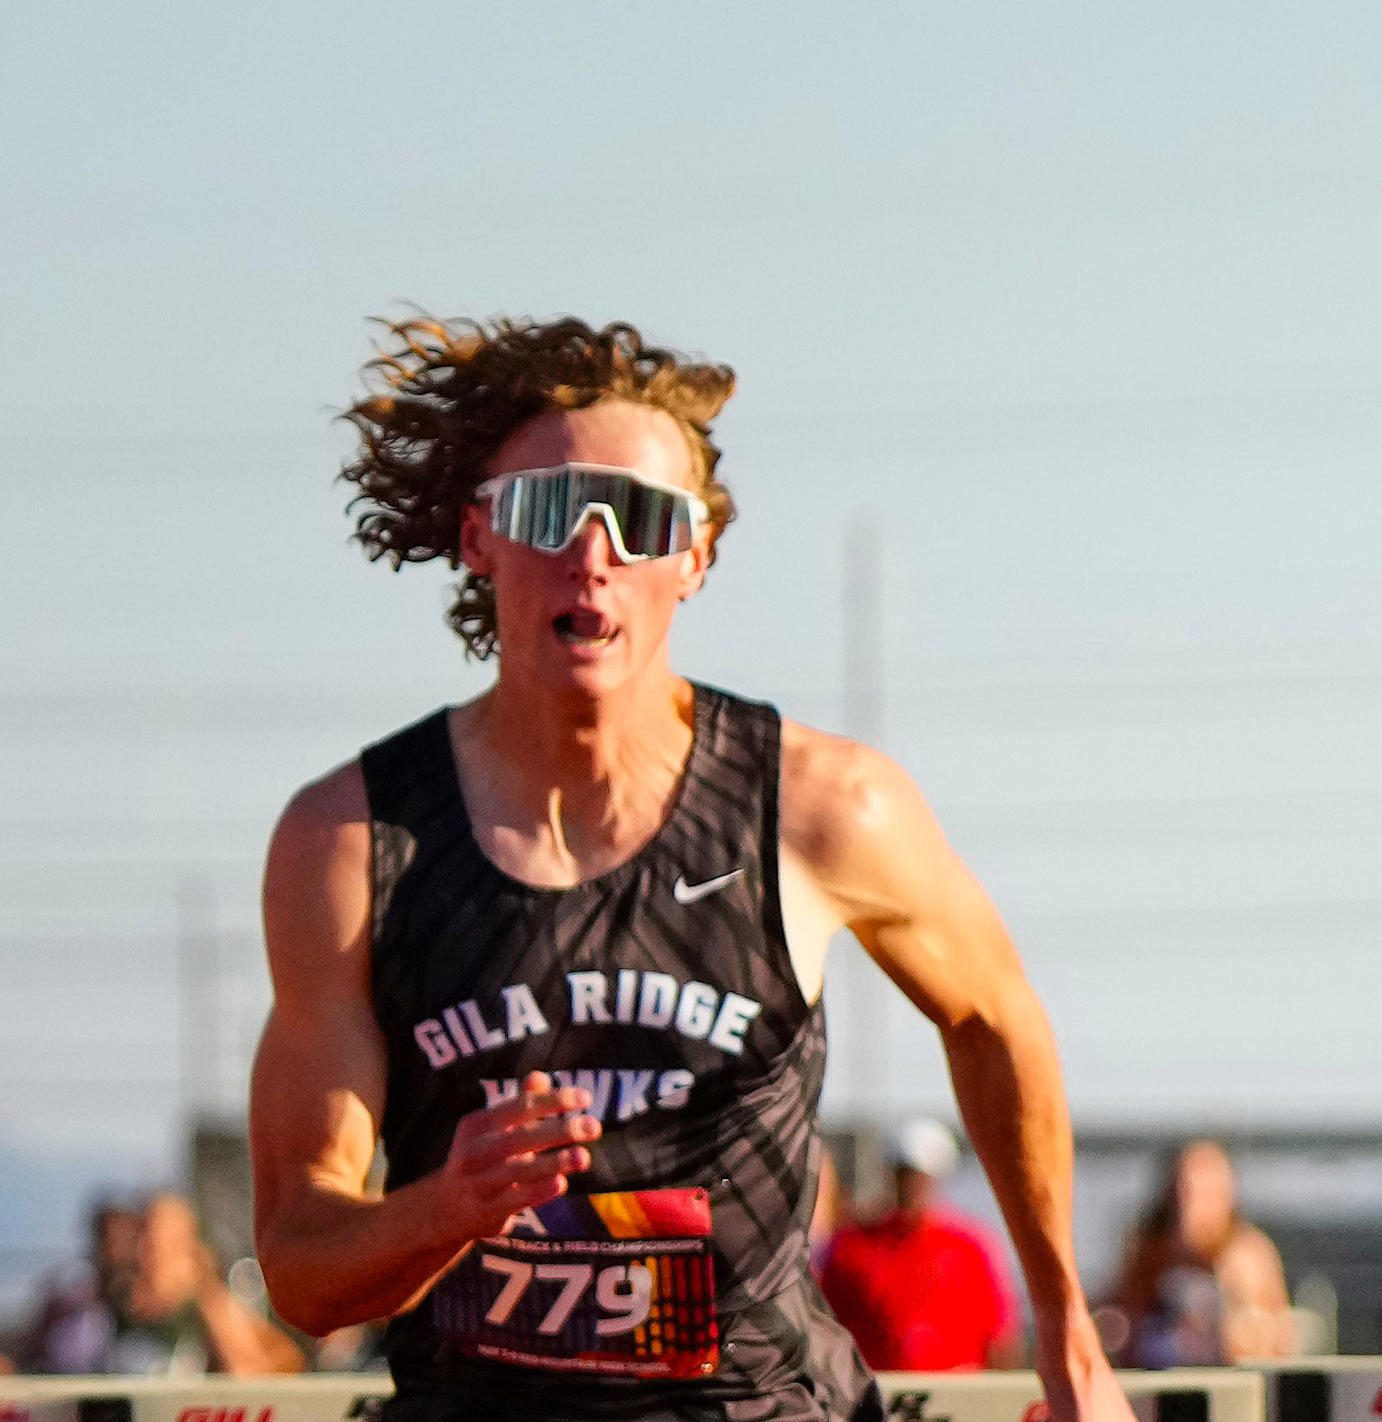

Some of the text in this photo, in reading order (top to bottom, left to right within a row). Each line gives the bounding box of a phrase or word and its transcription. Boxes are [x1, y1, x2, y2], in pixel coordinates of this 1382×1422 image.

[413, 969, 762, 1070] GILA RIDGE
[480, 1069, 695, 1122] HWKS
[481, 1254, 652, 1337] 779
